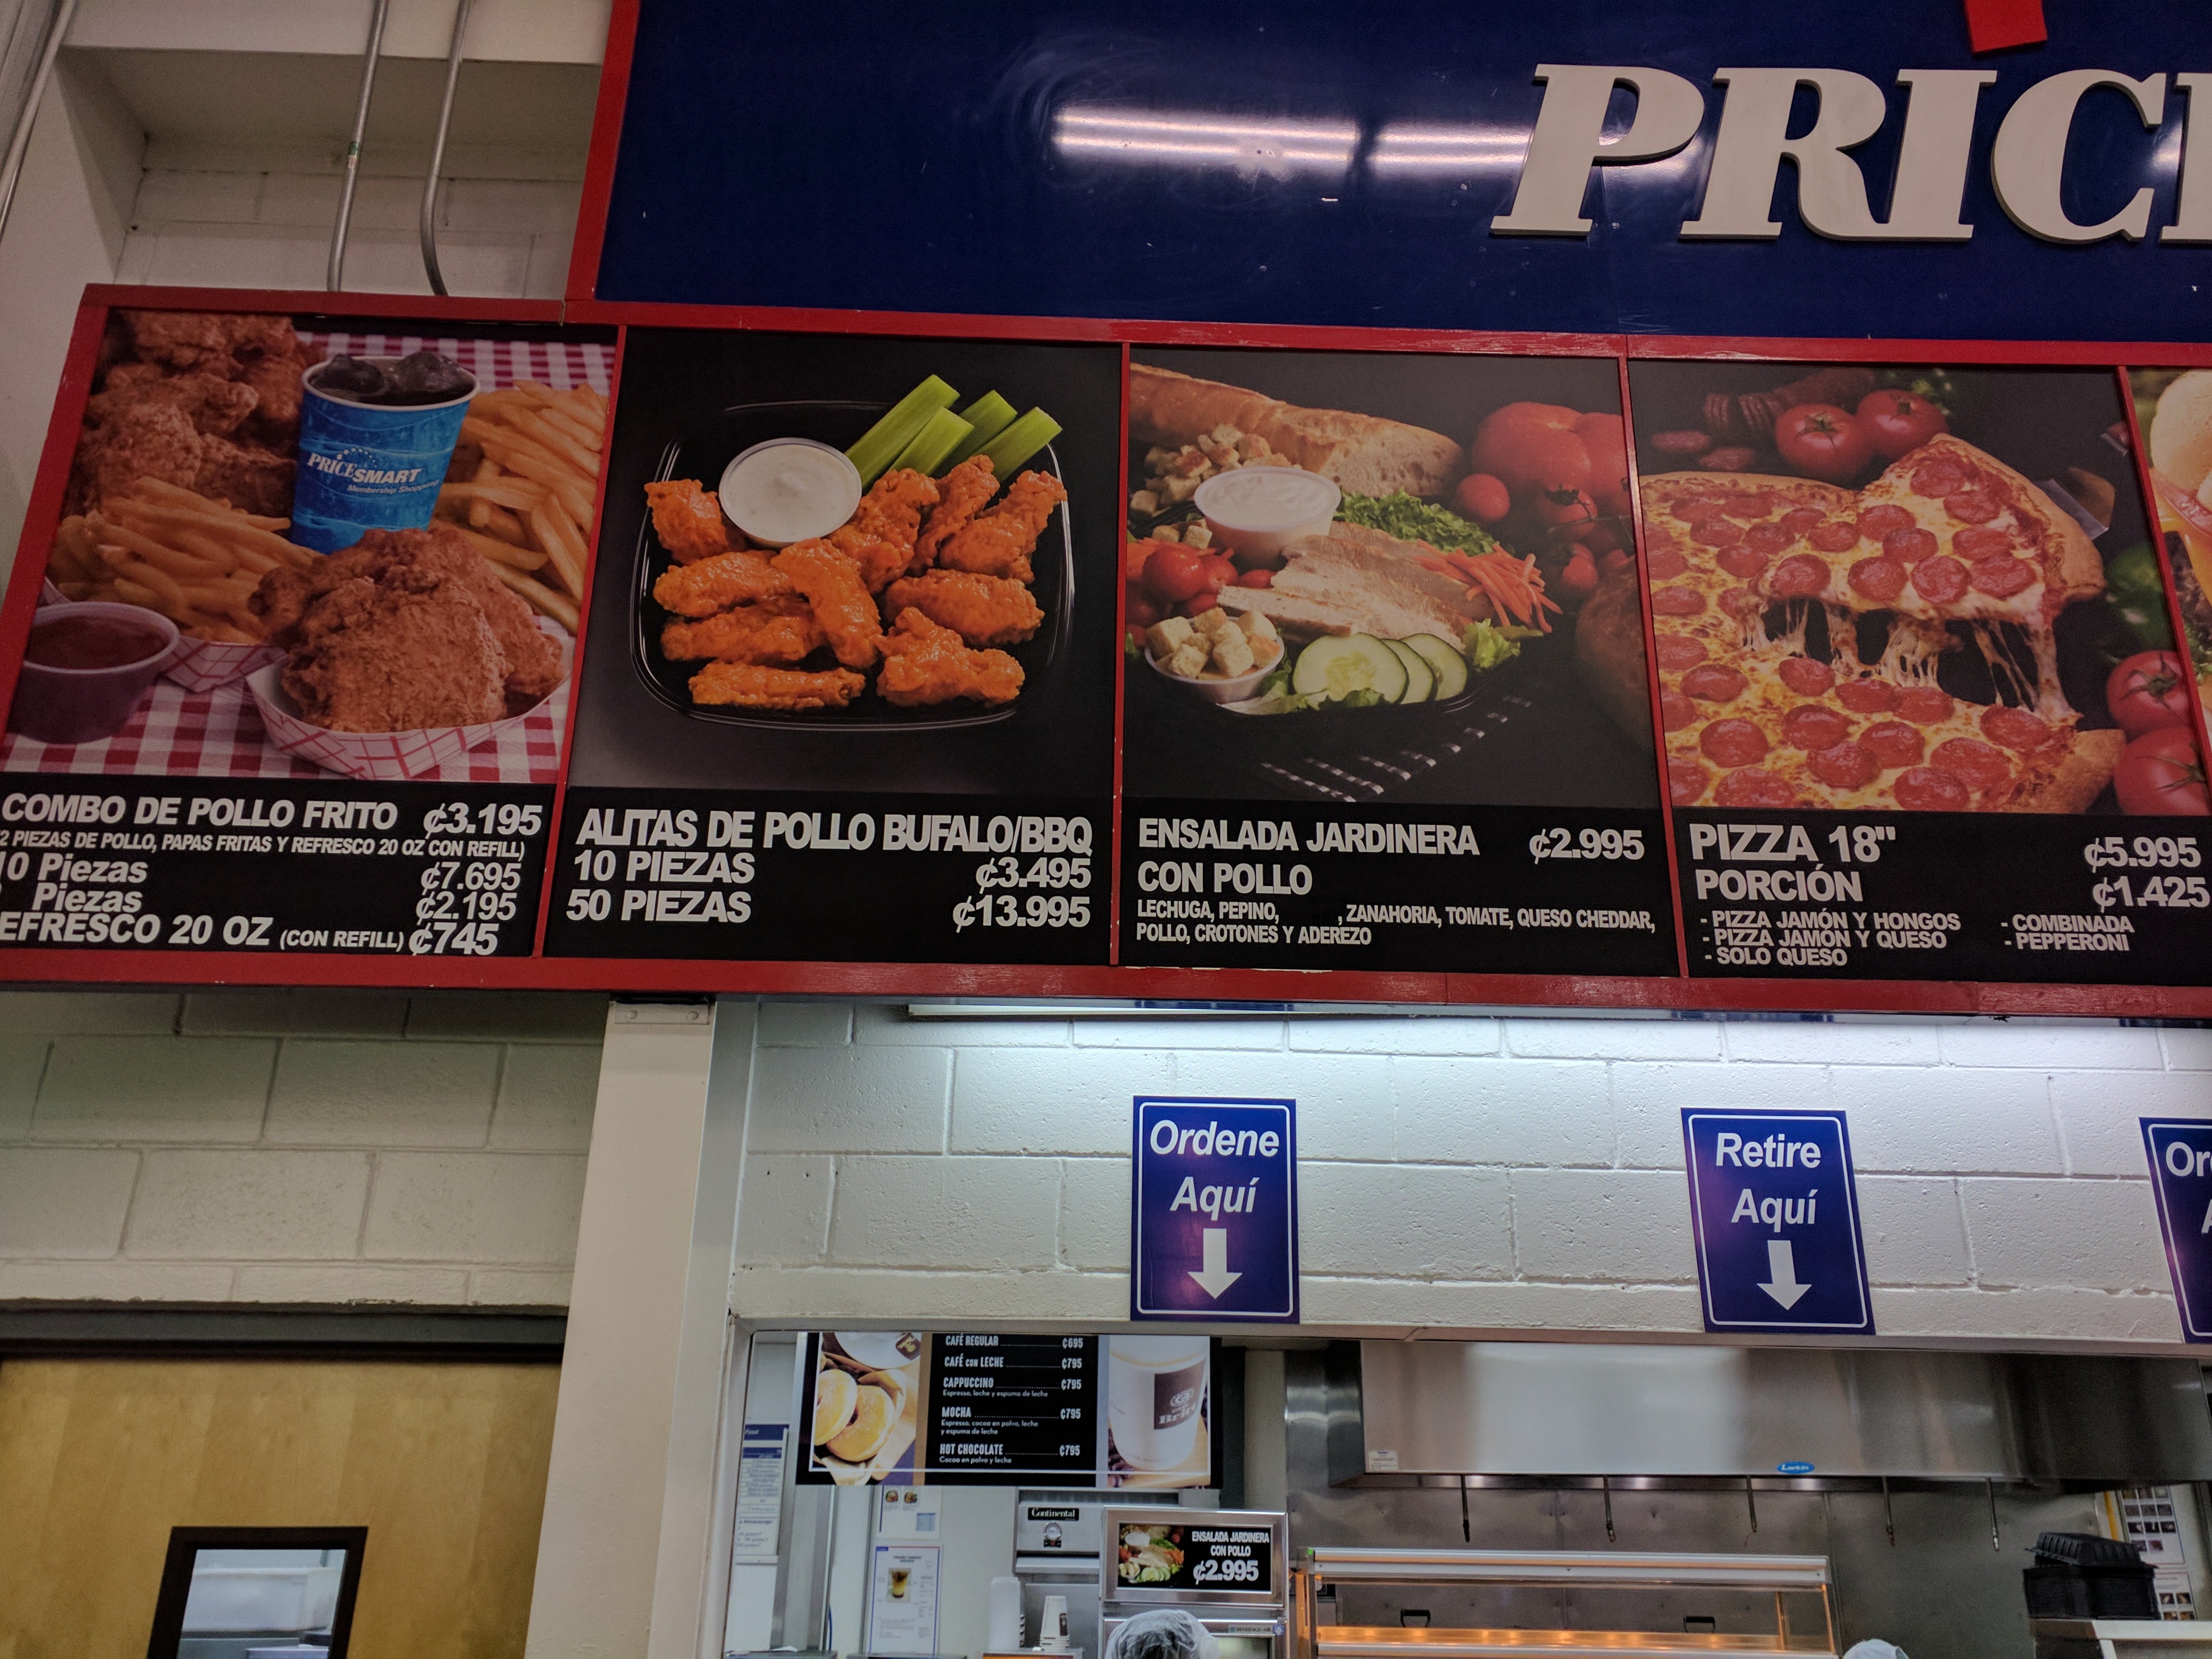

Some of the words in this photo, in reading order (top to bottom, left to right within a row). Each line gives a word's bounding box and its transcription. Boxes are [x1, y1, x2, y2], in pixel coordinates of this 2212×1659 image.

[347, 484, 397, 494] Membership
[2, 793, 126, 824] COMBO
[134, 797, 181, 825] DE
[187, 798, 295, 827] POLLO
[303, 801, 398, 830] FRITO
[0, 830, 10, 846] 2
[12, 831, 71, 848] PIEZAS
[74, 832, 98, 848] DE
[100, 833, 157, 853] POLLO,
[162, 834, 213, 851] PAPAS
[216, 835, 272, 852] FRITAS
[277, 836, 289, 852] Y
[291, 837, 375, 854] REFRESCO
[378, 839, 398, 855] 20
[402, 840, 425, 856] OZ
[429, 840, 464, 856] CON
[467, 841, 524, 861] REFILL)
[575, 809, 698, 847] ALITAS
[707, 811, 755, 848] DE
[763, 812, 875, 850] POLLO
[883, 814, 1092, 857] BUFALO/BBQ
[1139, 818, 1299, 851] ENSALADA
[1306, 822, 1480, 855] JARDINERA
[1690, 824, 1819, 861] PIZZA
[38, 853, 148, 883] Piezas
[574, 850, 616, 881] 10
[626, 851, 755, 883] PIEZAS
[1138, 861, 1203, 892] CON
[1214, 863, 1312, 895] POLLO
[1696, 864, 1863, 901] PORCIÓN
[32, 883, 143, 912] Piezas
[566, 889, 611, 920] 50
[621, 890, 751, 923] PIEZAS
[1138, 900, 1214, 923] LECHUGA,
[1219, 902, 1279, 924] PEPINO,
[1346, 904, 1442, 928] ZANAHORIA,
[1445, 907, 1513, 929] TOMATE,
[1518, 909, 1572, 927] QUESO
[1576, 910, 1655, 933] CHEDDAR,
[1712, 911, 1772, 927] PIZZA
[1777, 908, 1848, 929] JAMÓN
[1853, 912, 1867, 929] Y
[1873, 912, 1960, 930] HONGOS
[2013, 914, 2135, 932] COMBINADA
[169, 915, 213, 944] 20
[223, 916, 273, 945] OZ
[280, 930, 329, 950] (CON
[333, 931, 404, 952] REFILL)
[1137, 923, 1190, 944] POLLO,
[1195, 924, 1278, 943] CROTONES
[1283, 926, 1294, 943] Y
[1298, 926, 1371, 944] ADEREZO
[1714, 928, 1774, 946] PIZZA
[1779, 926, 1851, 947] JAMÓN
[1855, 931, 1870, 947] Y
[1876, 931, 1947, 949] QUESO
[2016, 933, 2129, 951] PEPPERONI
[1717, 947, 1771, 965] SOLO
[1777, 948, 1847, 966] QUESO
[1150, 1120, 1279, 1157] Ordene
[1716, 1133, 1821, 1168] Retire
[1170, 1177, 1260, 1221] Aquí
[1731, 1188, 1818, 1233] Aquí
[945, 1333, 963, 1346] CAFÉ
[965, 1335, 999, 1346] REGULAR
[945, 1353, 963, 1367] CAFÉ
[981, 1357, 1004, 1367] LECHE
[943, 1377, 993, 1388] CAPPUCCINO
[942, 1407, 971, 1417] MOCHA
[940, 1444, 956, 1454] HOT
[958, 1444, 1003, 1455] CHOCOLATE
[1032, 1507, 1076, 1518] Continental
[1192, 1531, 1229, 1542] ENSALADA
[1230, 1531, 1270, 1543] JARDINERA
[1211, 1545, 1226, 1556] CON
[1228, 1545, 1251, 1556] POLLO
